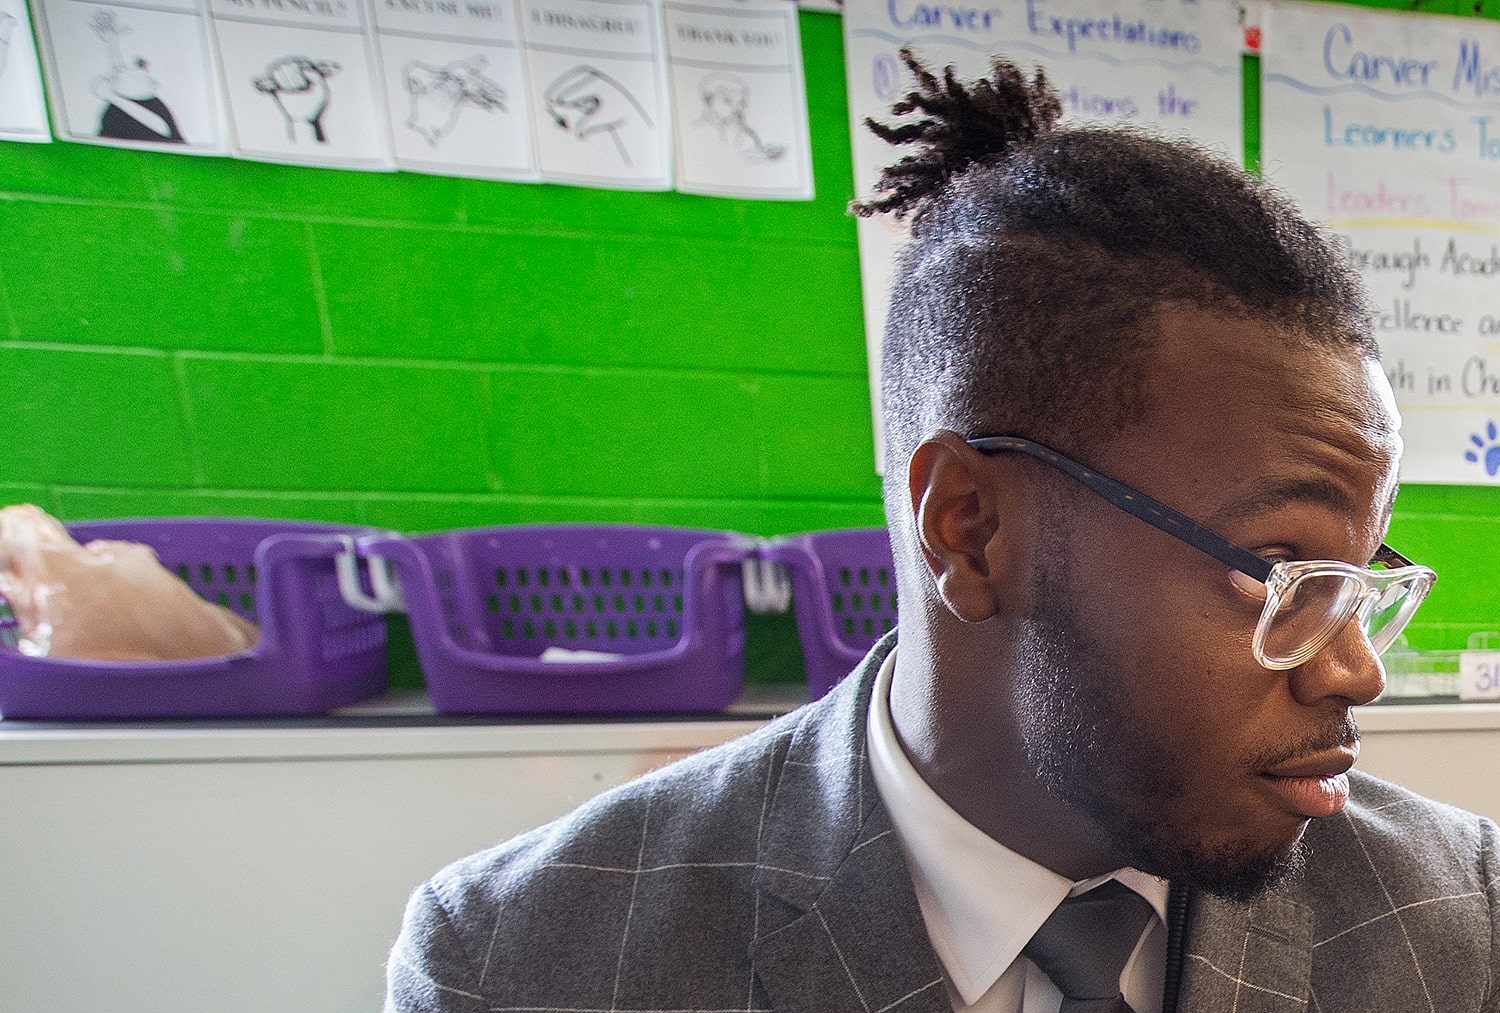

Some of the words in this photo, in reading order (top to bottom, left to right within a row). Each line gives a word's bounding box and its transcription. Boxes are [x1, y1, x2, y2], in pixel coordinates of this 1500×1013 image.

[1323, 23, 1438, 87] Carver
[1158, 82, 1200, 117] the
[1322, 103, 1457, 152] Learners
[1326, 170, 1430, 218] Leaders
[1350, 237, 1430, 289] rough
[1379, 296, 1464, 334] ellence
[1427, 366, 1451, 396] in
